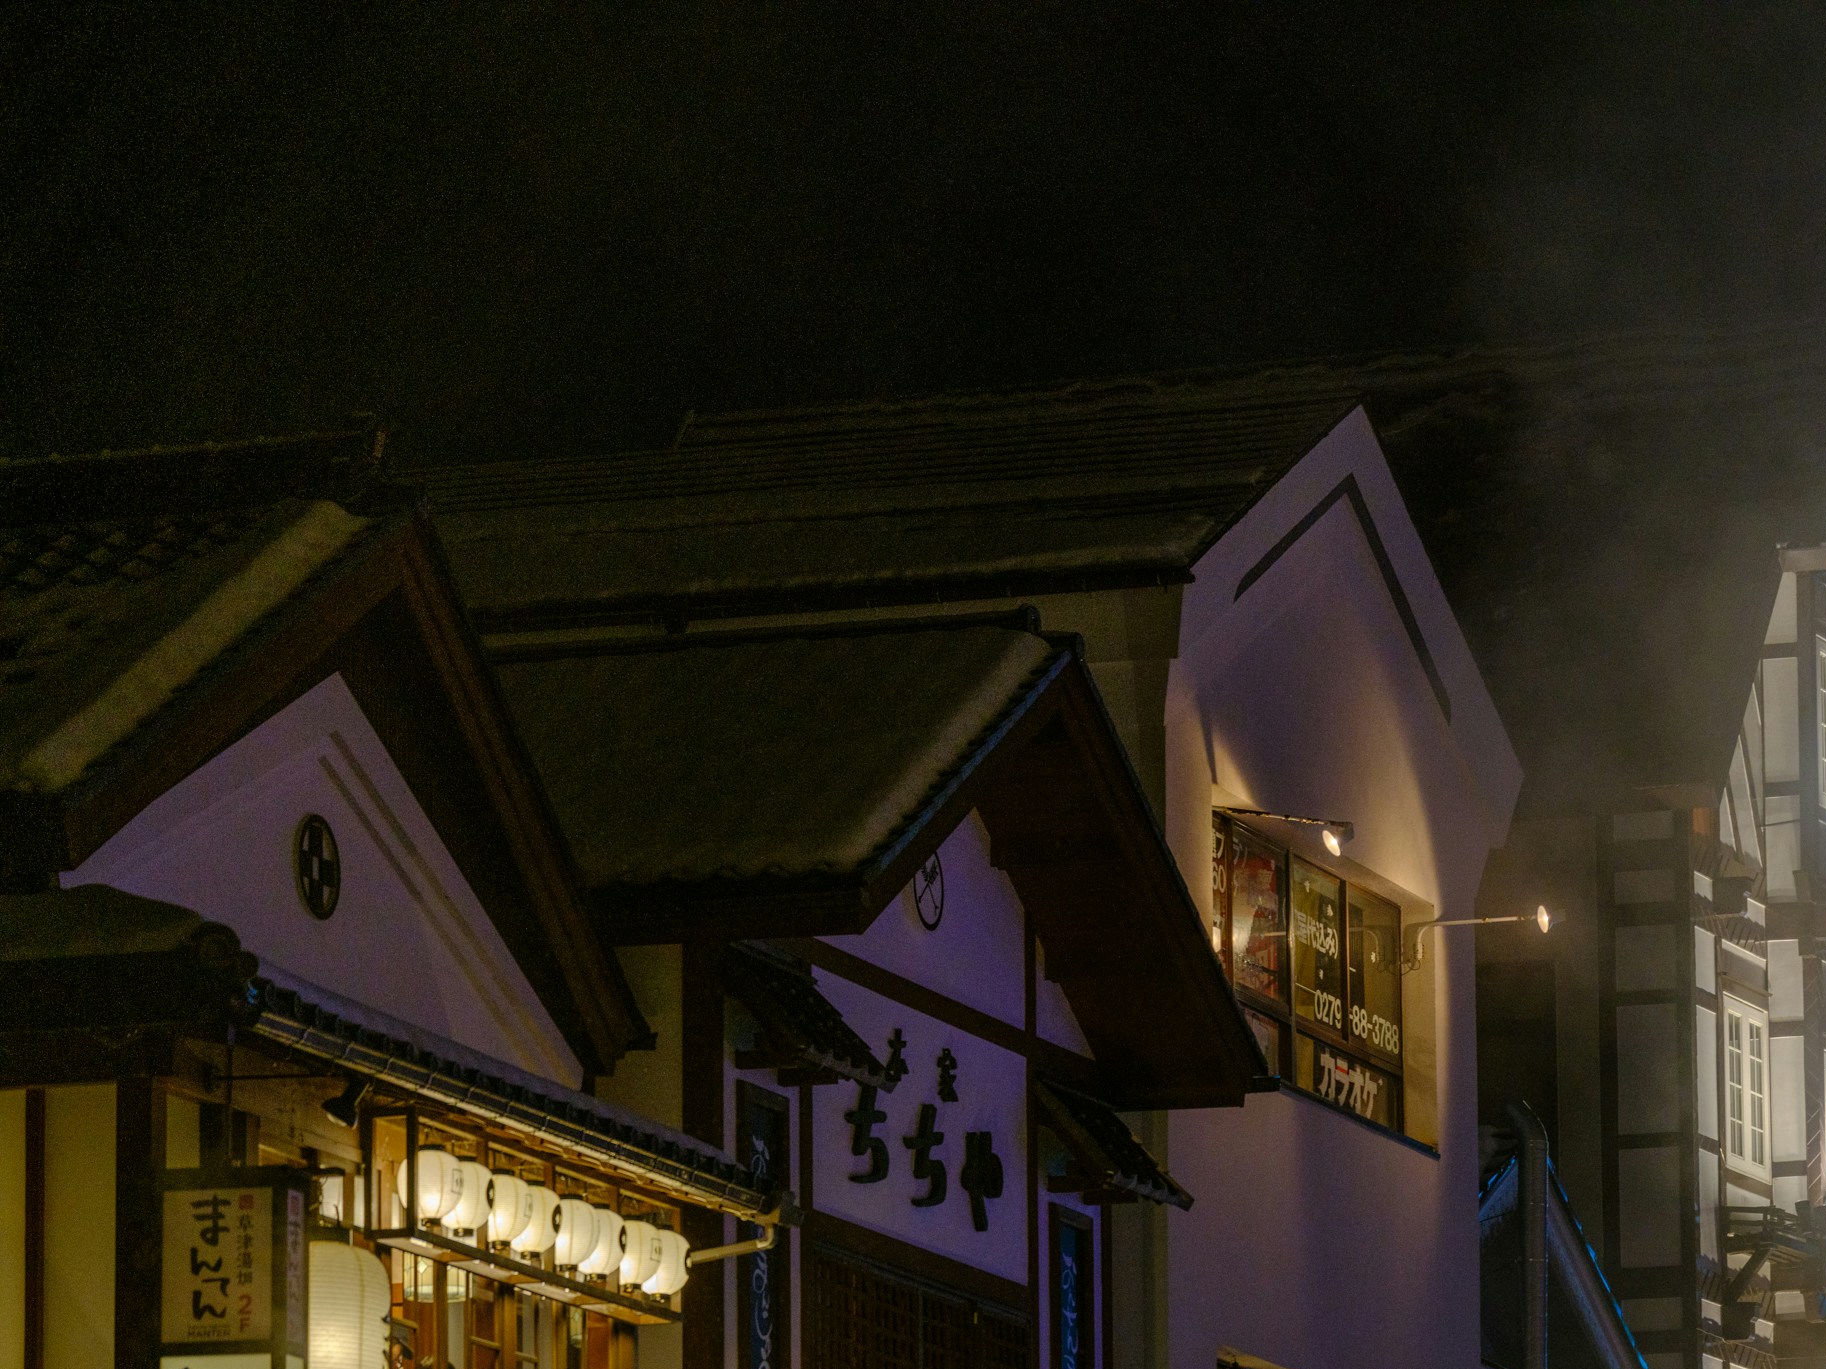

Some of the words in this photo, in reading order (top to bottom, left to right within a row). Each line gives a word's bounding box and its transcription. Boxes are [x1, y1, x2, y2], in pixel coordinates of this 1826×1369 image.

[1320, 1050, 1378, 1119] カラオケ
[844, 1085, 1004, 1232] ちちや
[190, 1195, 231, 1320] まんてん
